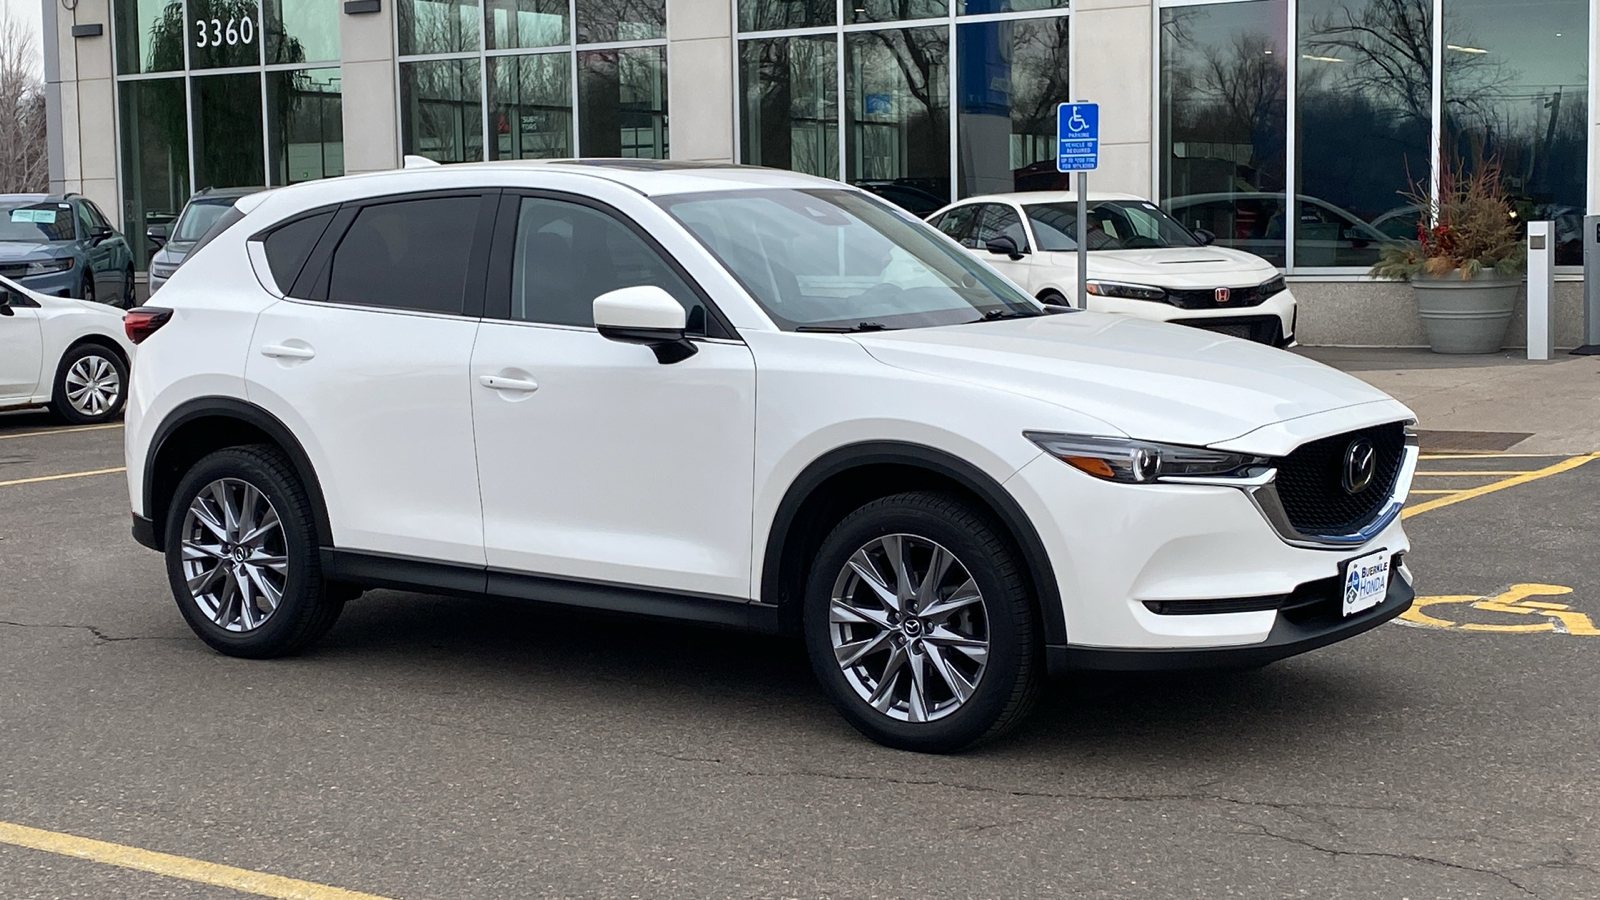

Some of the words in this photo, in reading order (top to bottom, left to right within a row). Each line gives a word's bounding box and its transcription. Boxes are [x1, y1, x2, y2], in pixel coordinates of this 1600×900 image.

[196, 16, 253, 48] 3360
[1362, 562, 1388, 578] BUERKLE
[1360, 576, 1384, 597] HONDA
